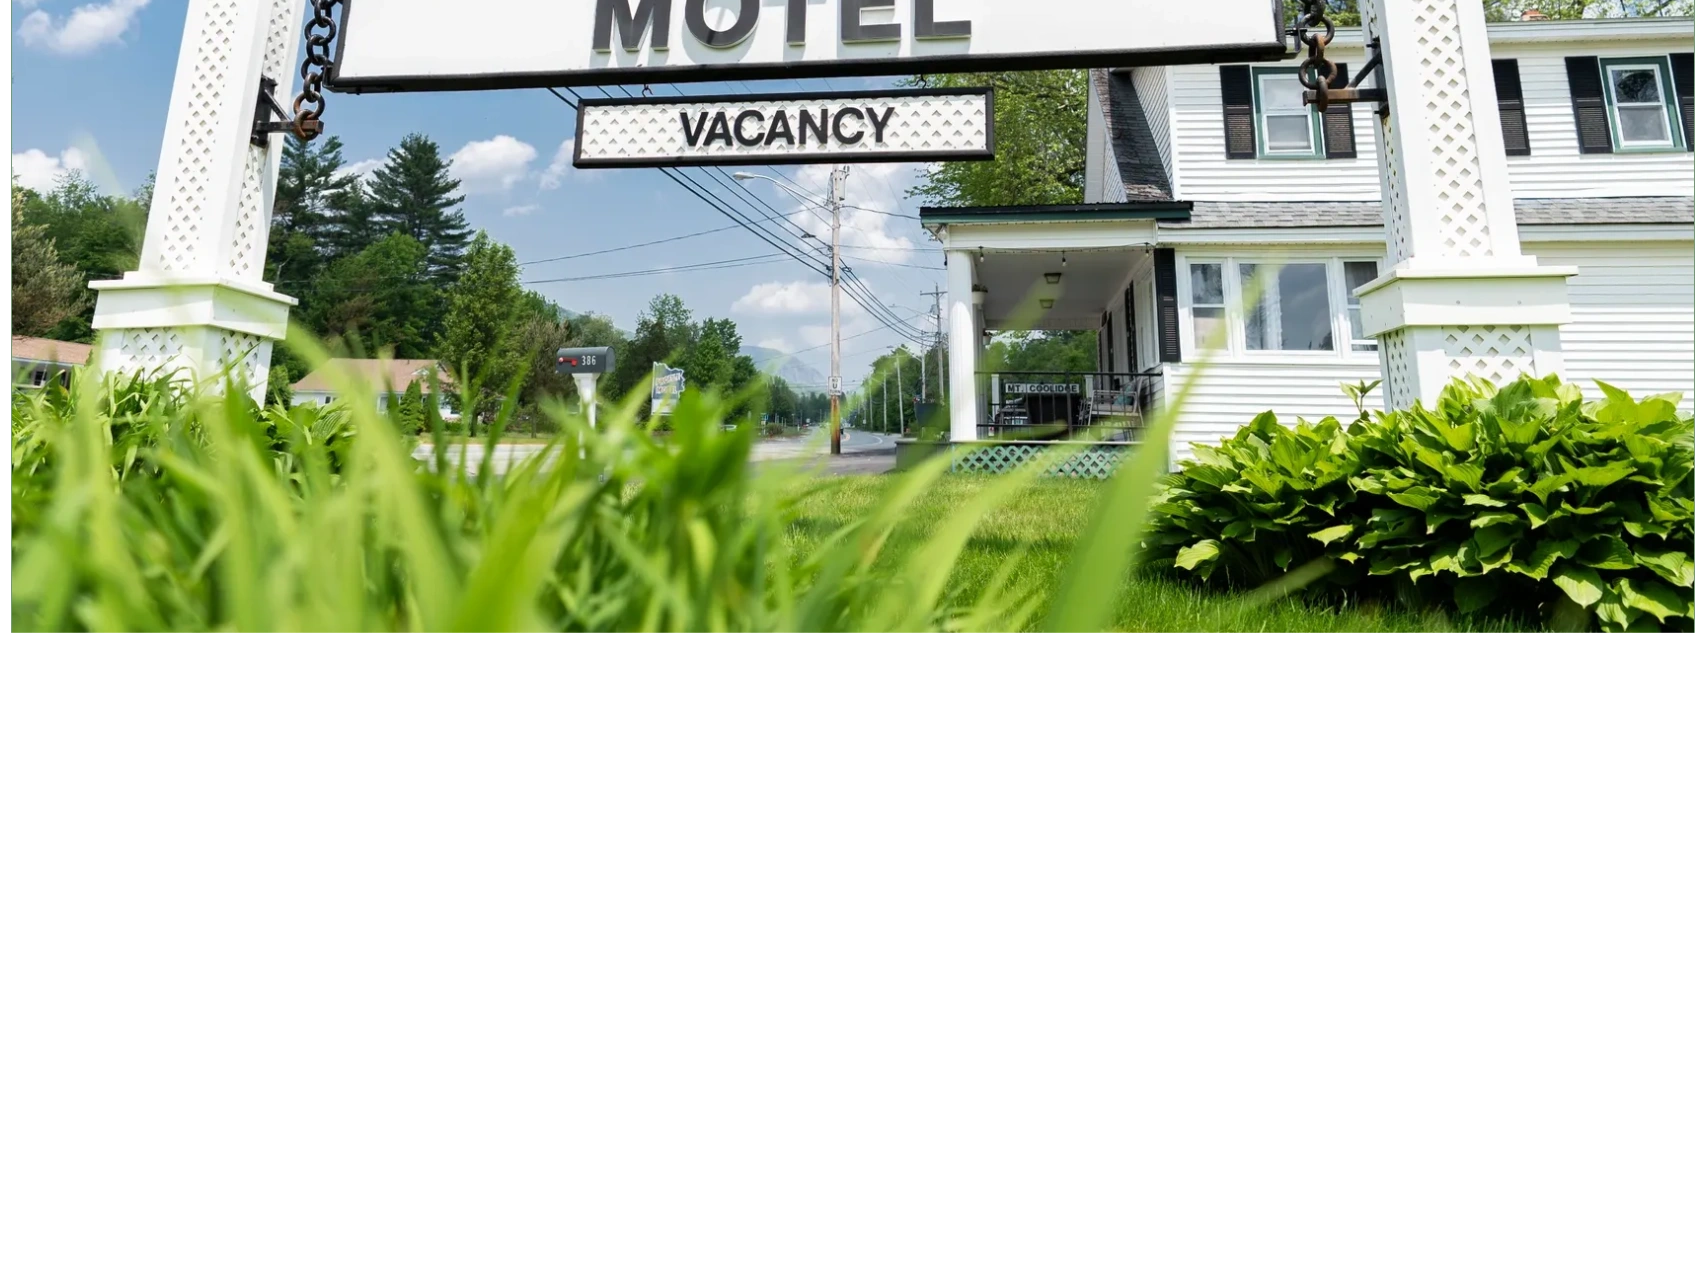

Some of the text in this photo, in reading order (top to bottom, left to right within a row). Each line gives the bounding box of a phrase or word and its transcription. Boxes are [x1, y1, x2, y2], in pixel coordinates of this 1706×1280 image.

[679, 106, 895, 146] VACANCY
[581, 355, 596, 366] 386
[1007, 384, 1024, 393] MT.
